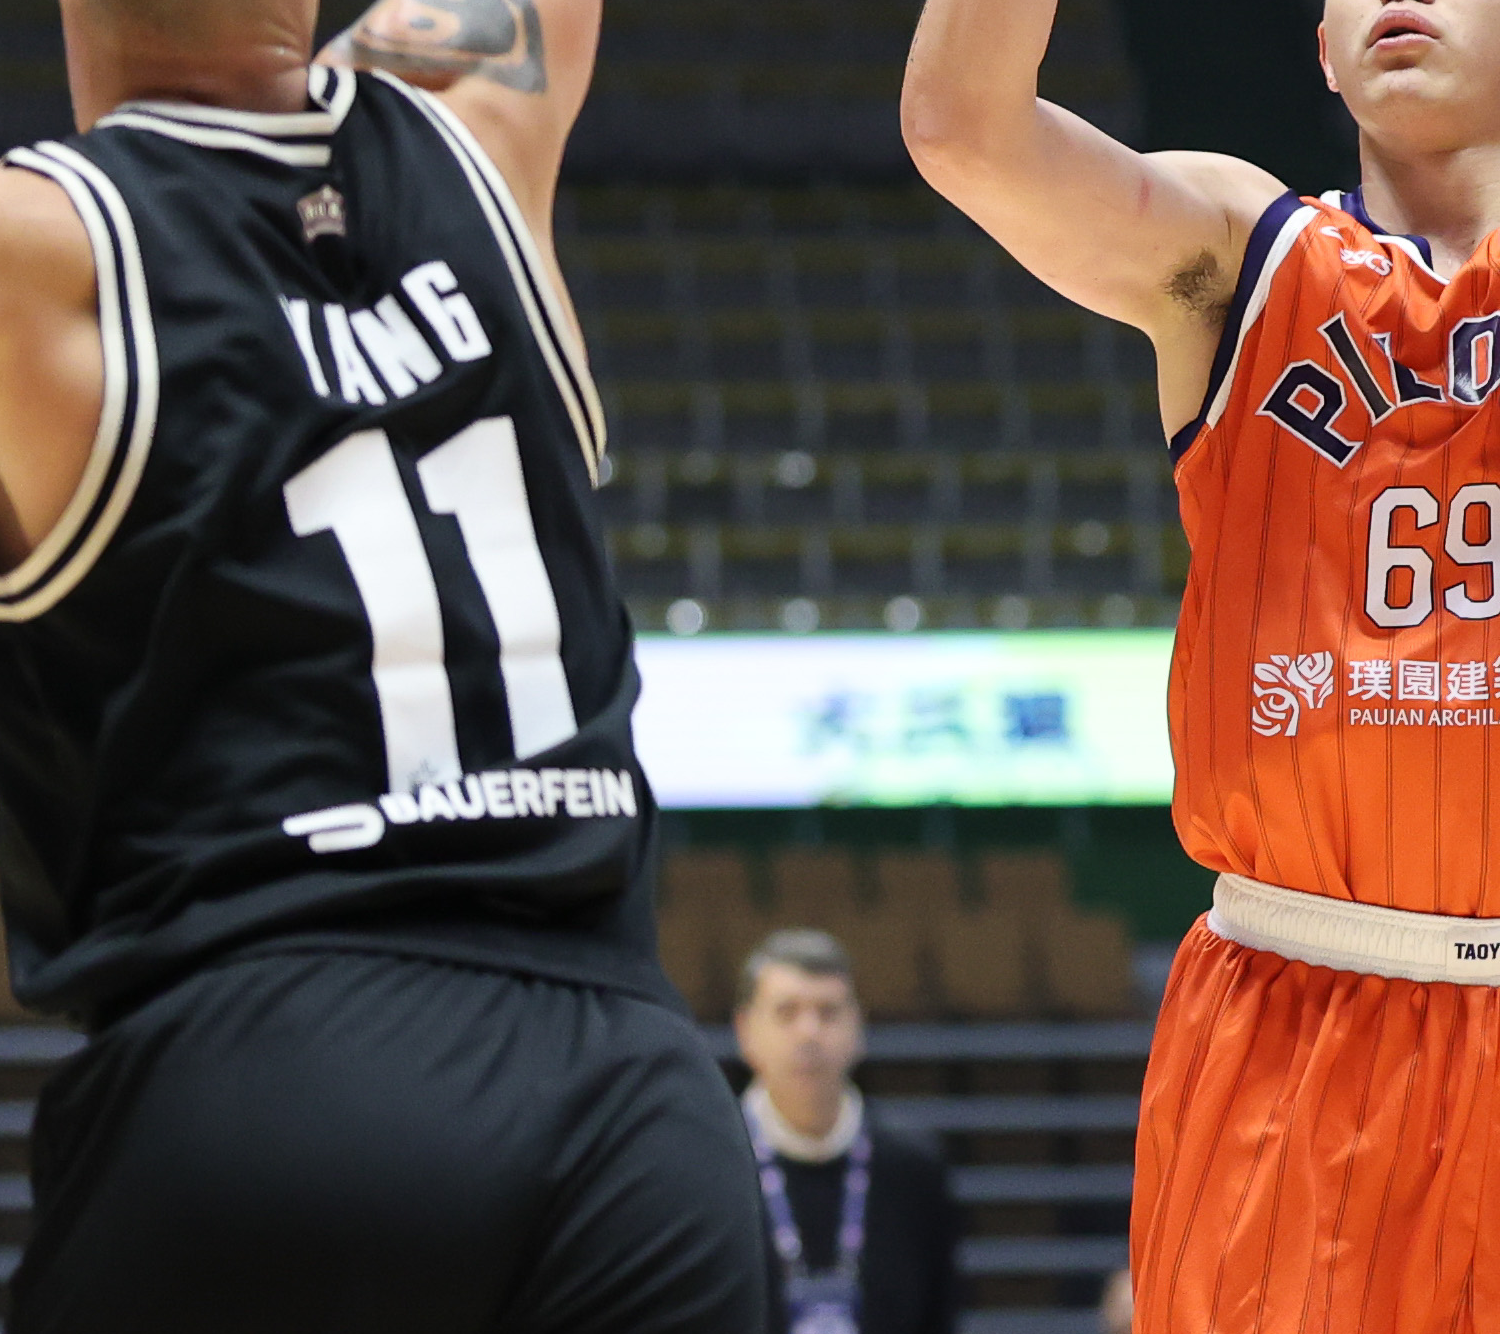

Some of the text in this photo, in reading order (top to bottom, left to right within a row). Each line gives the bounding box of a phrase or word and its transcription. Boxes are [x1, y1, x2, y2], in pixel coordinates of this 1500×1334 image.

[278, 259, 493, 407] YANG
[283, 414, 579, 797] 11
[1349, 707, 1423, 727] PAUIAN
